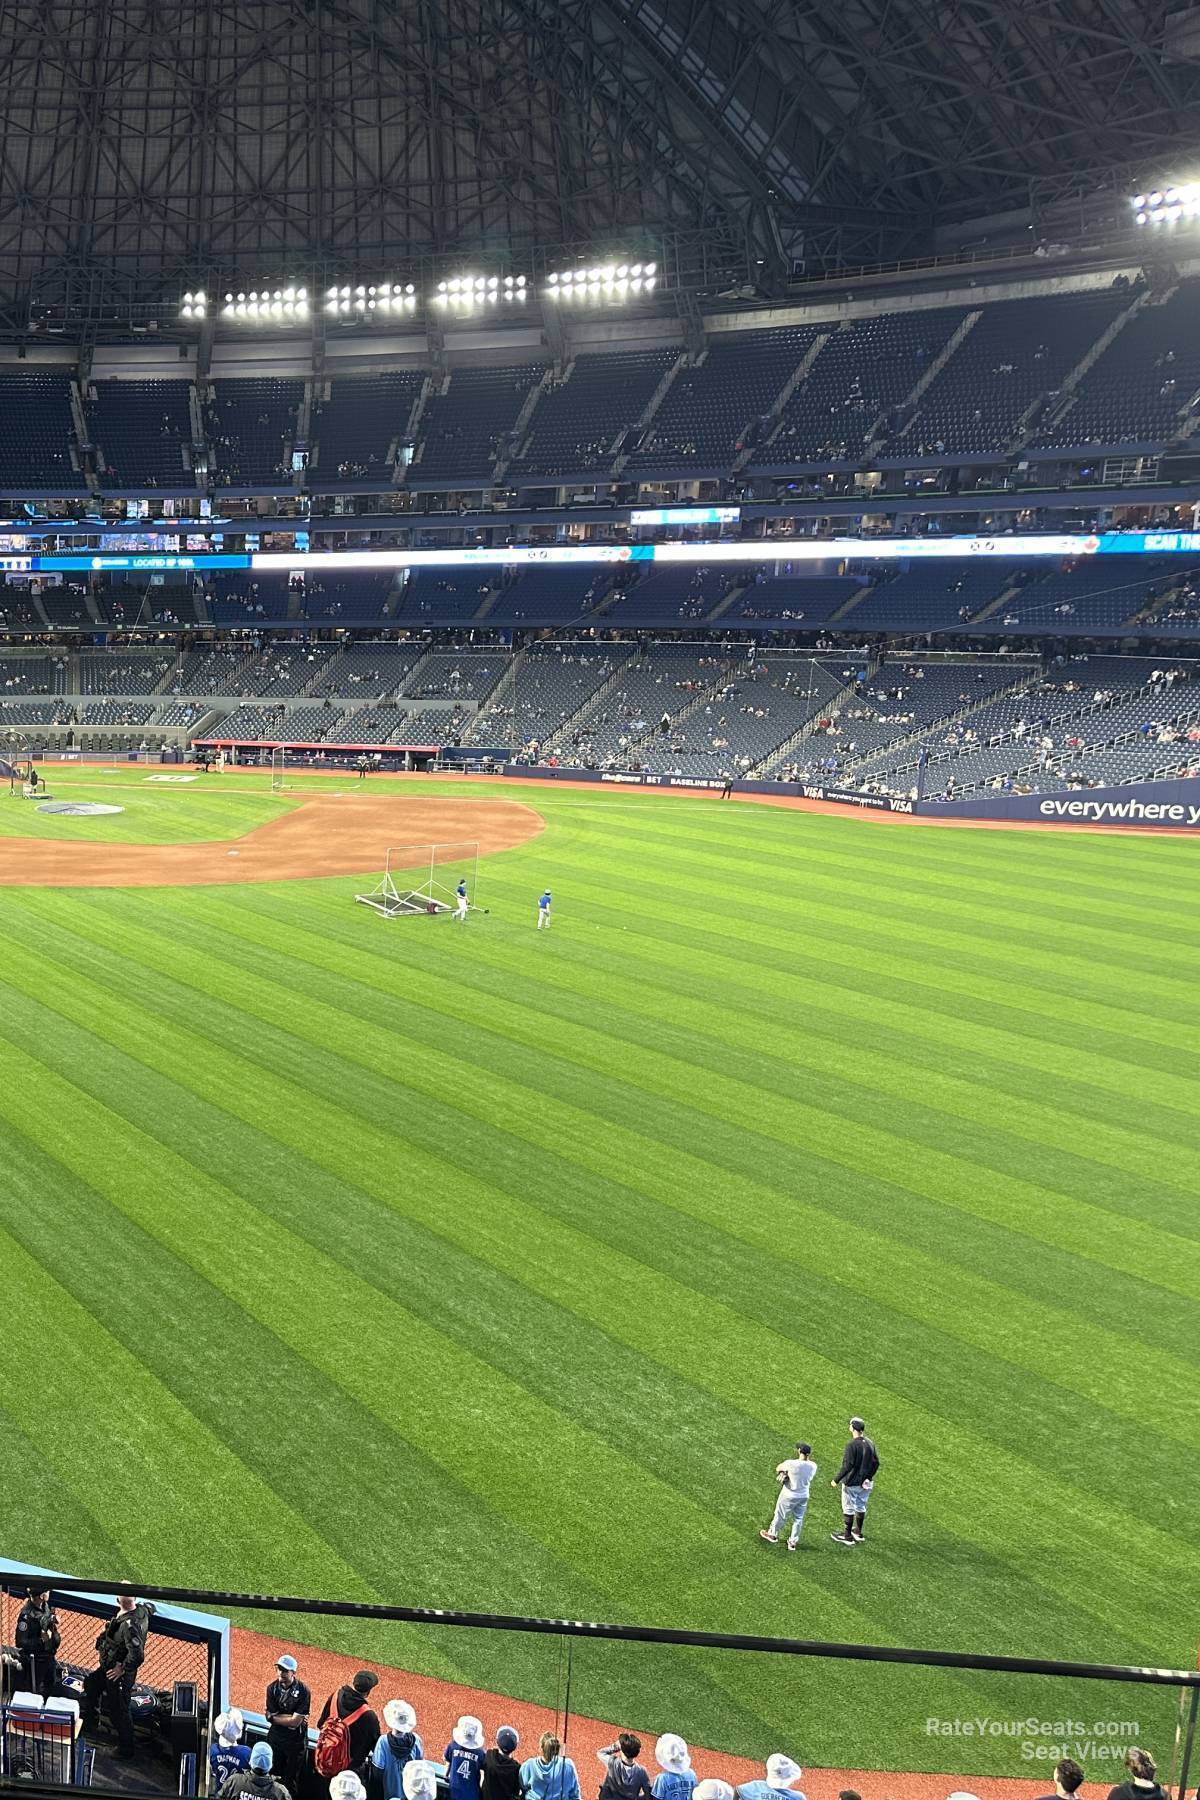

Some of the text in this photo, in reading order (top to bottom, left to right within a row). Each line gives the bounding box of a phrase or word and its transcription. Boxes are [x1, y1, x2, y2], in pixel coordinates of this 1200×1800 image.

[647, 776, 662, 784] BET
[670, 778, 708, 787] BASELINE
[709, 780, 726, 789] BOX
[803, 786, 824, 799] VISA
[888, 799, 913, 813] VISA
[1039, 799, 1184, 821] everywhere
[456, 1760, 471, 1779] 4
